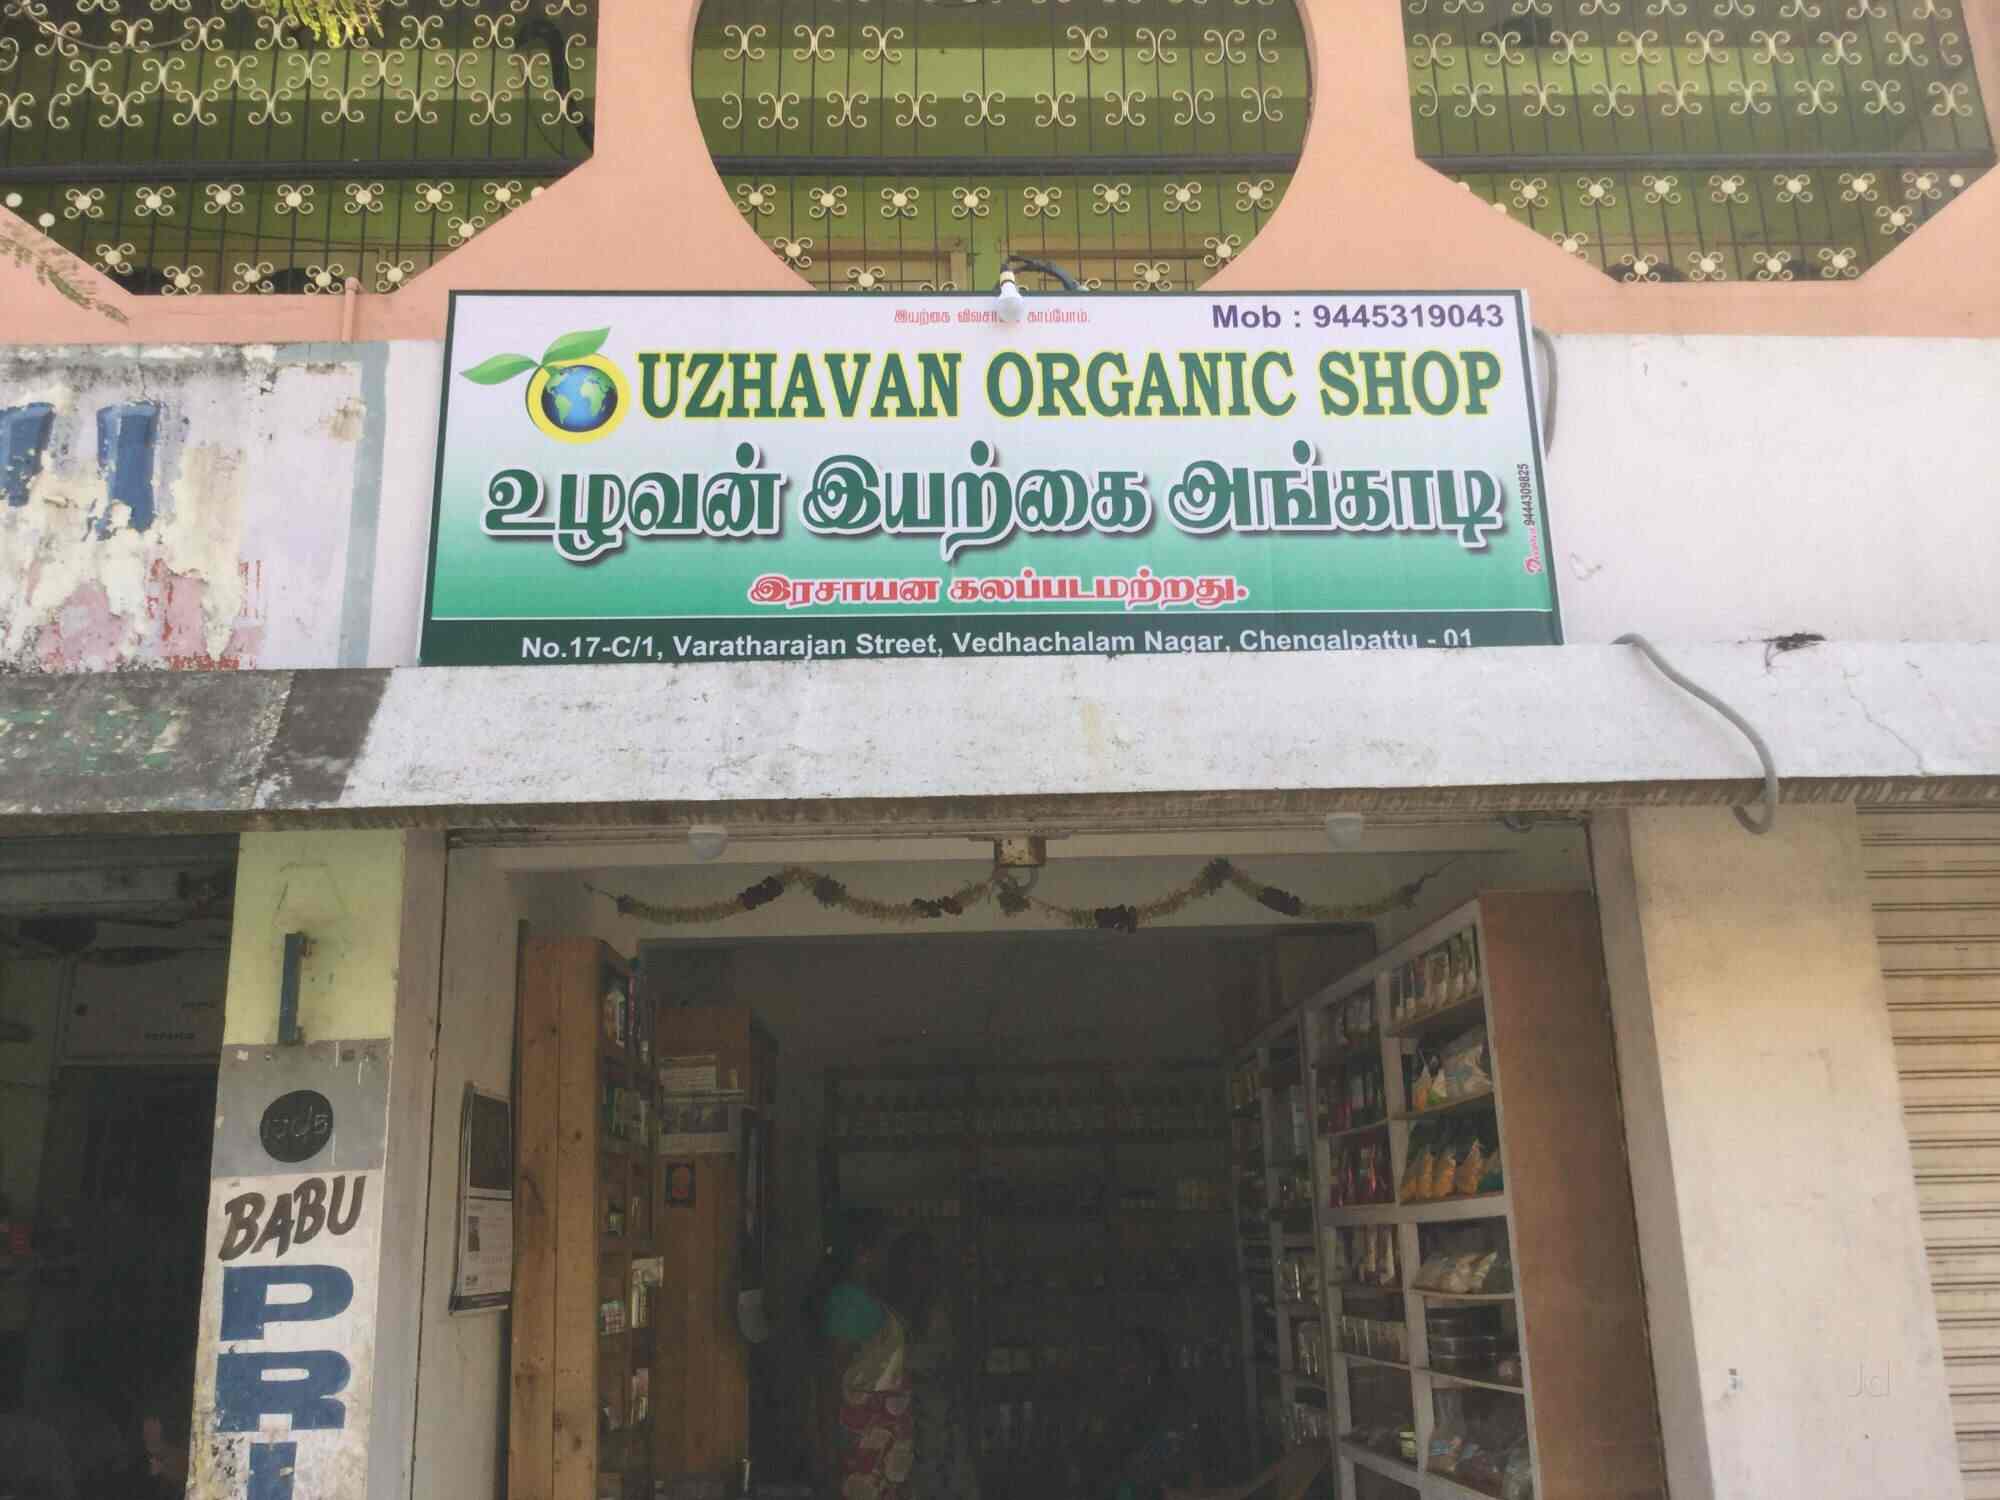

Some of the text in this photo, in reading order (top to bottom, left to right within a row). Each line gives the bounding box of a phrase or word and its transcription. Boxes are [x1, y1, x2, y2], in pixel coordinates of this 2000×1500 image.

[1212, 304, 1282, 329] Mob
[1312, 303, 1505, 328] 9445319043
[637, 350, 1502, 419] UZHAVAN ORGANIC SHOP
[482, 436, 1507, 563] உழவன் இயற்கை அங்காடி
[1516, 463, 1537, 526] 9444309825
[747, 567, 1249, 609] இரசாயன கலப்படமற்றது.
[520, 634, 664, 661] No.17-C/1,
[672, 632, 847, 661] Varatharajan
[855, 632, 944, 657] Street,
[951, 630, 1136, 653] Vedhachalam
[1144, 629, 1230, 653] Nagar,
[1239, 627, 1418, 651] Chengalpattu
[217, 1175, 366, 1262] BABU
